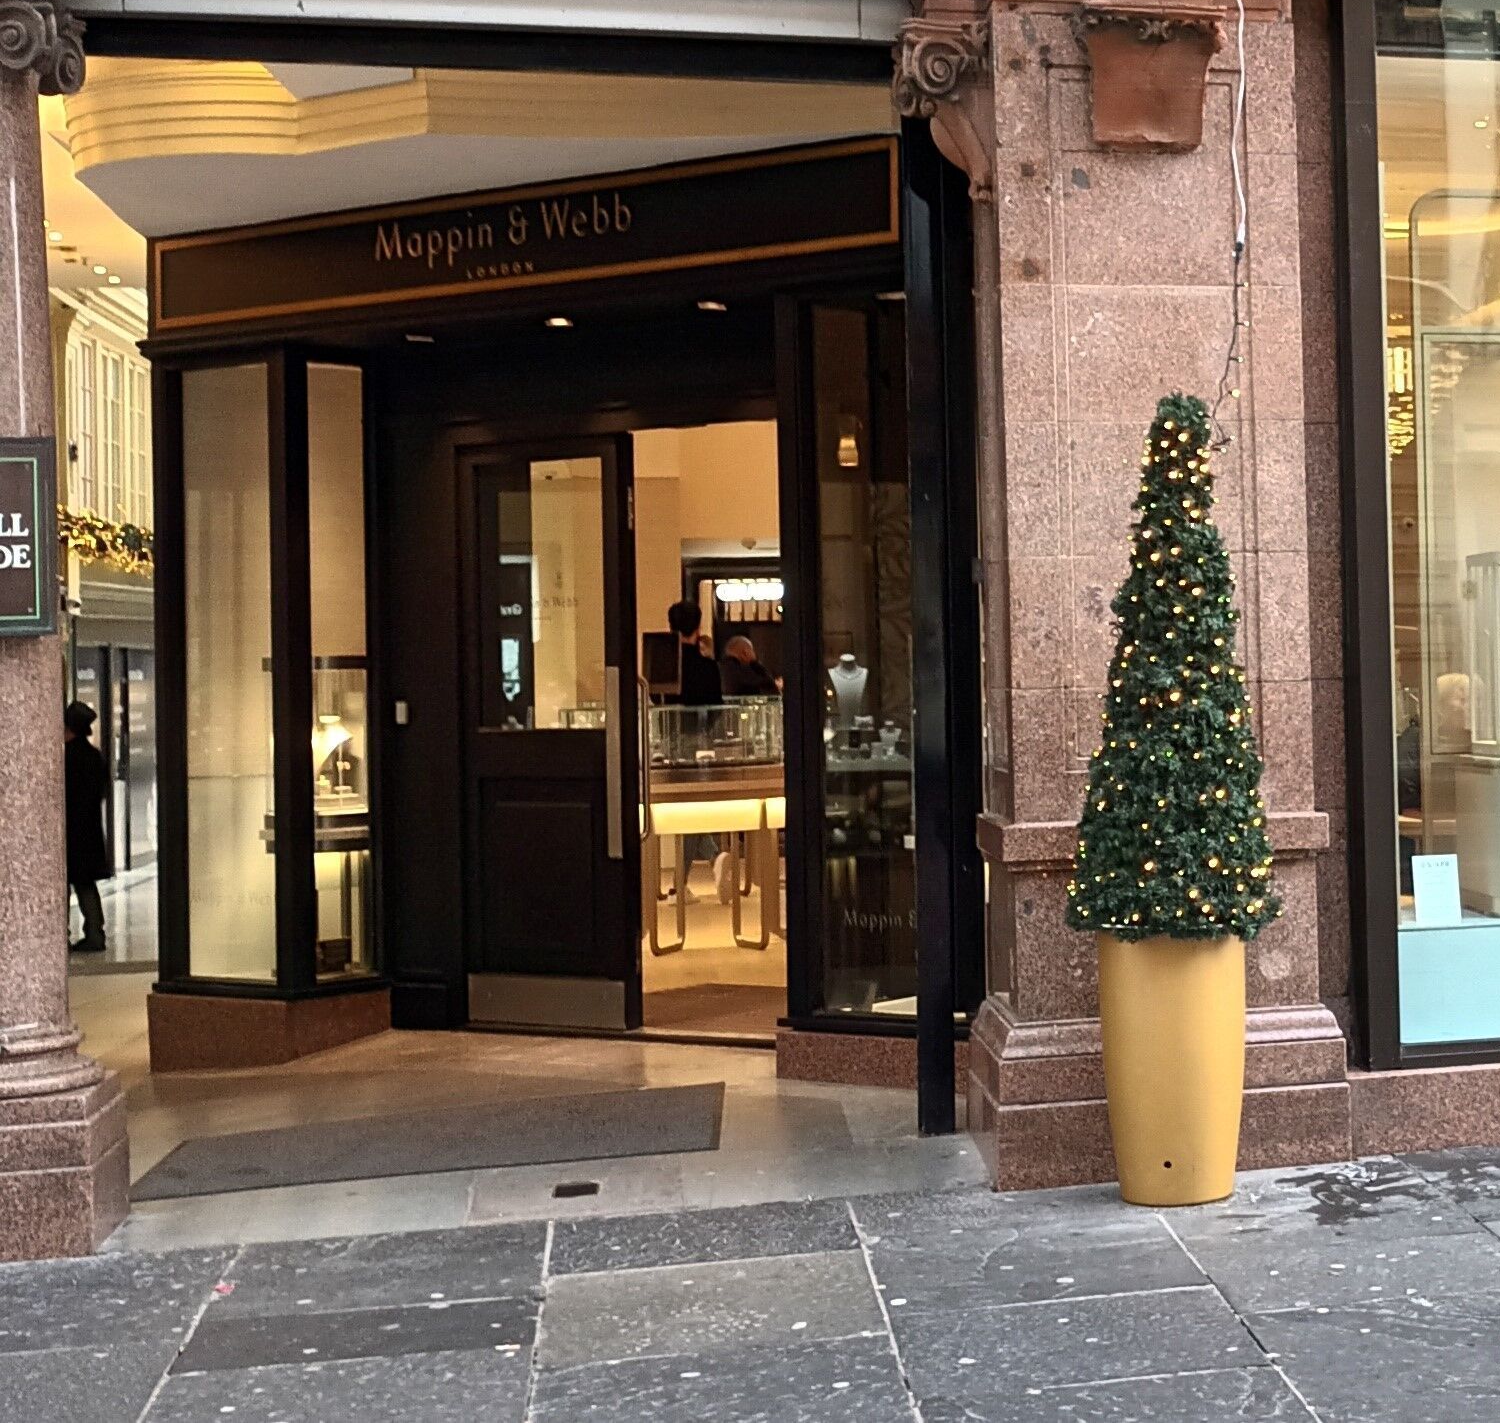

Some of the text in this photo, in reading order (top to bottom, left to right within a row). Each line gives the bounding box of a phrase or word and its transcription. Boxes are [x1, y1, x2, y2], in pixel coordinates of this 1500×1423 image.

[374, 193, 632, 269] Mappin & Webb
[466, 260, 534, 279] LONDON
[844, 908, 901, 933] Mappin
